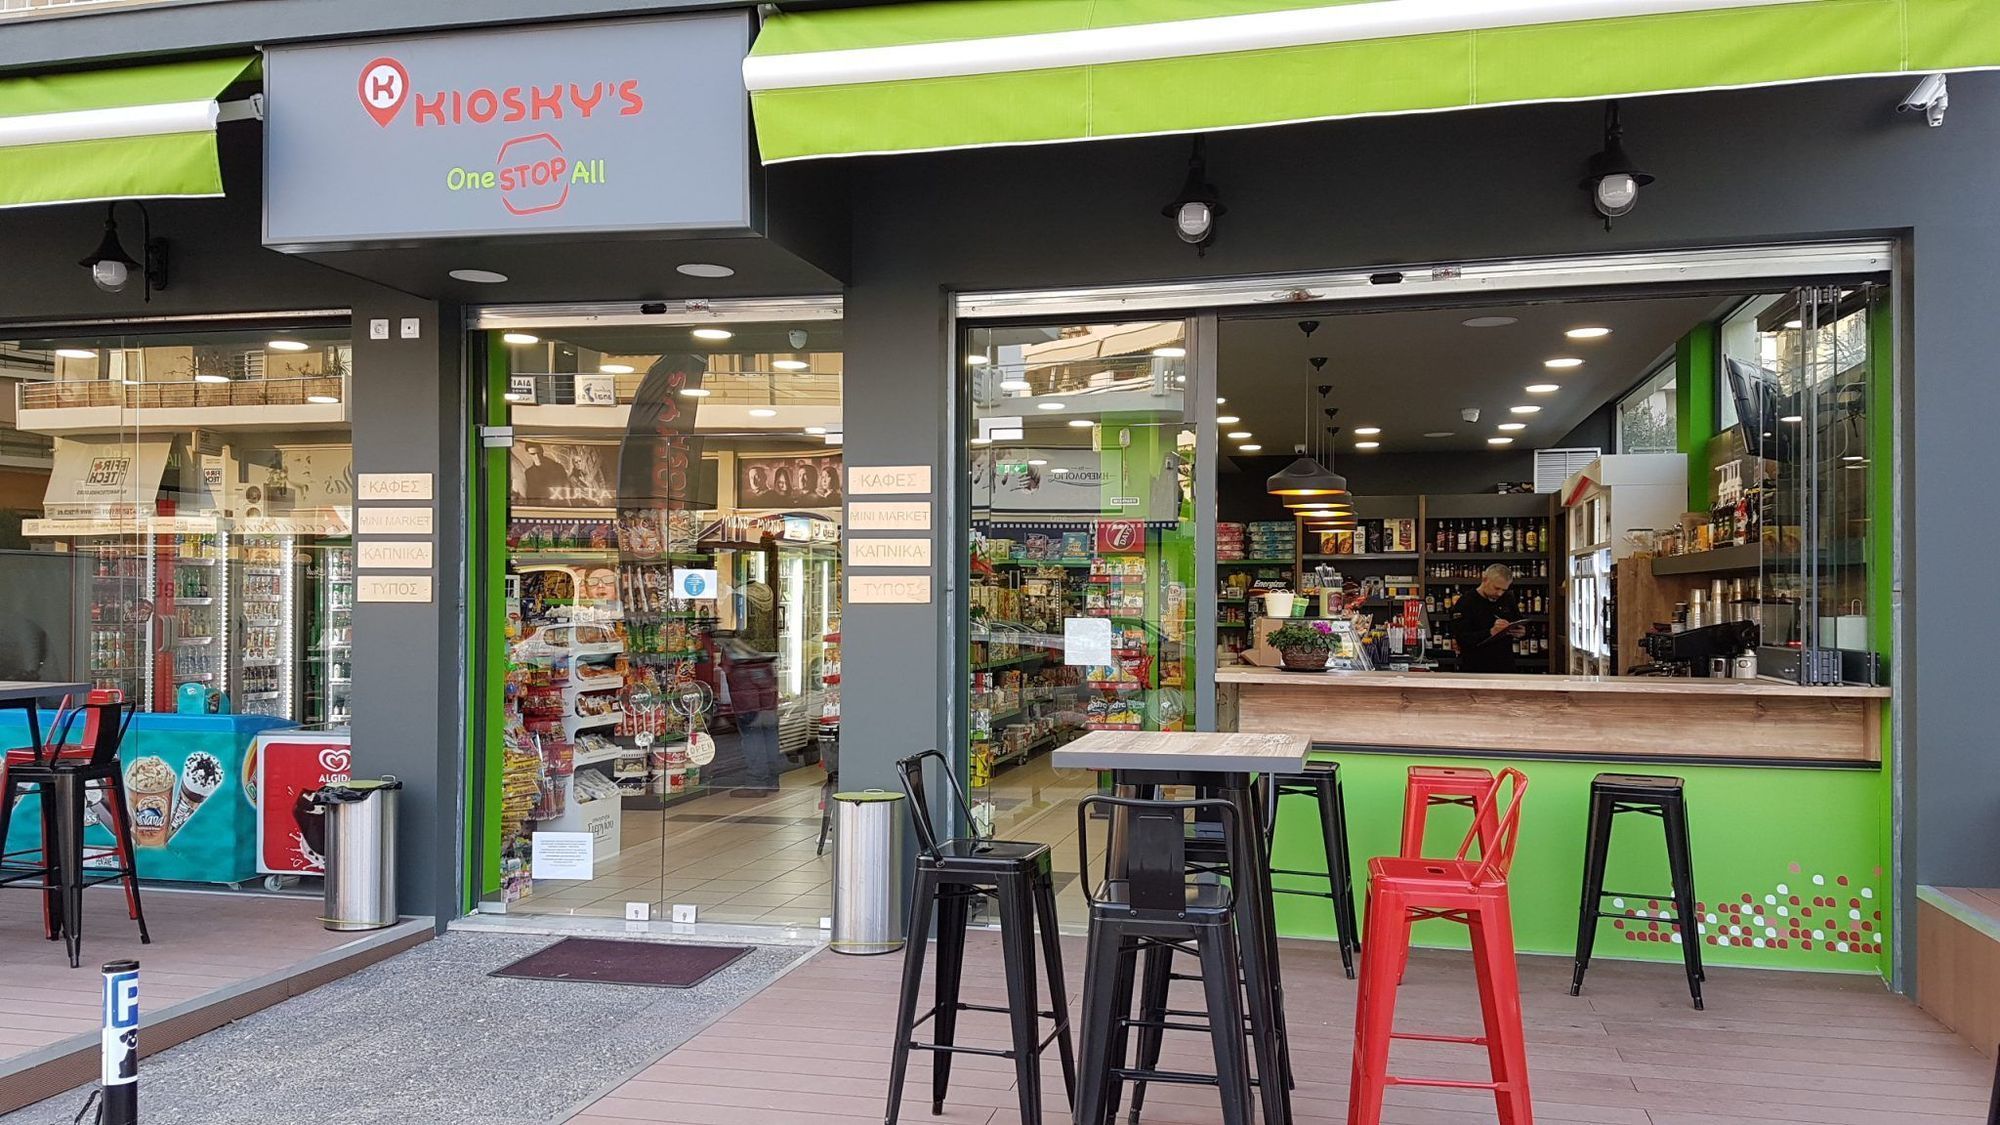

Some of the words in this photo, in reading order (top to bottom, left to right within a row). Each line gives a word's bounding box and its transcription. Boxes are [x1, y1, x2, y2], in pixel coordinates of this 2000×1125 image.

[372, 75, 394, 100] K
[415, 79, 645, 128] KIOSKY'S
[447, 167, 495, 191] One
[500, 157, 567, 192] STOP
[571, 160, 605, 184] All
[369, 481, 418, 493] ΚΑΦΕΣ
[861, 474, 916, 487] ΚΑΦΕΣ
[360, 516, 381, 526] MINI
[386, 516, 430, 526] MARKET
[850, 511, 875, 521] MINI
[879, 511, 928, 521] MARKET
[1111, 523, 1129, 546] 7
[1119, 528, 1132, 545] DAYS
[364, 548, 424, 559] ΚΑΠΝΙΚΑ
[856, 545, 922, 558] ΚΑΠΝΙΚΑ
[372, 583, 418, 595] ΤΥΠΟΣ
[864, 583, 915, 596] ΤΥΠΟΣ
[1253, 579, 1286, 589] Energizer
[689, 741, 714, 755] OPEN
[318, 774, 350, 783] ALGID
